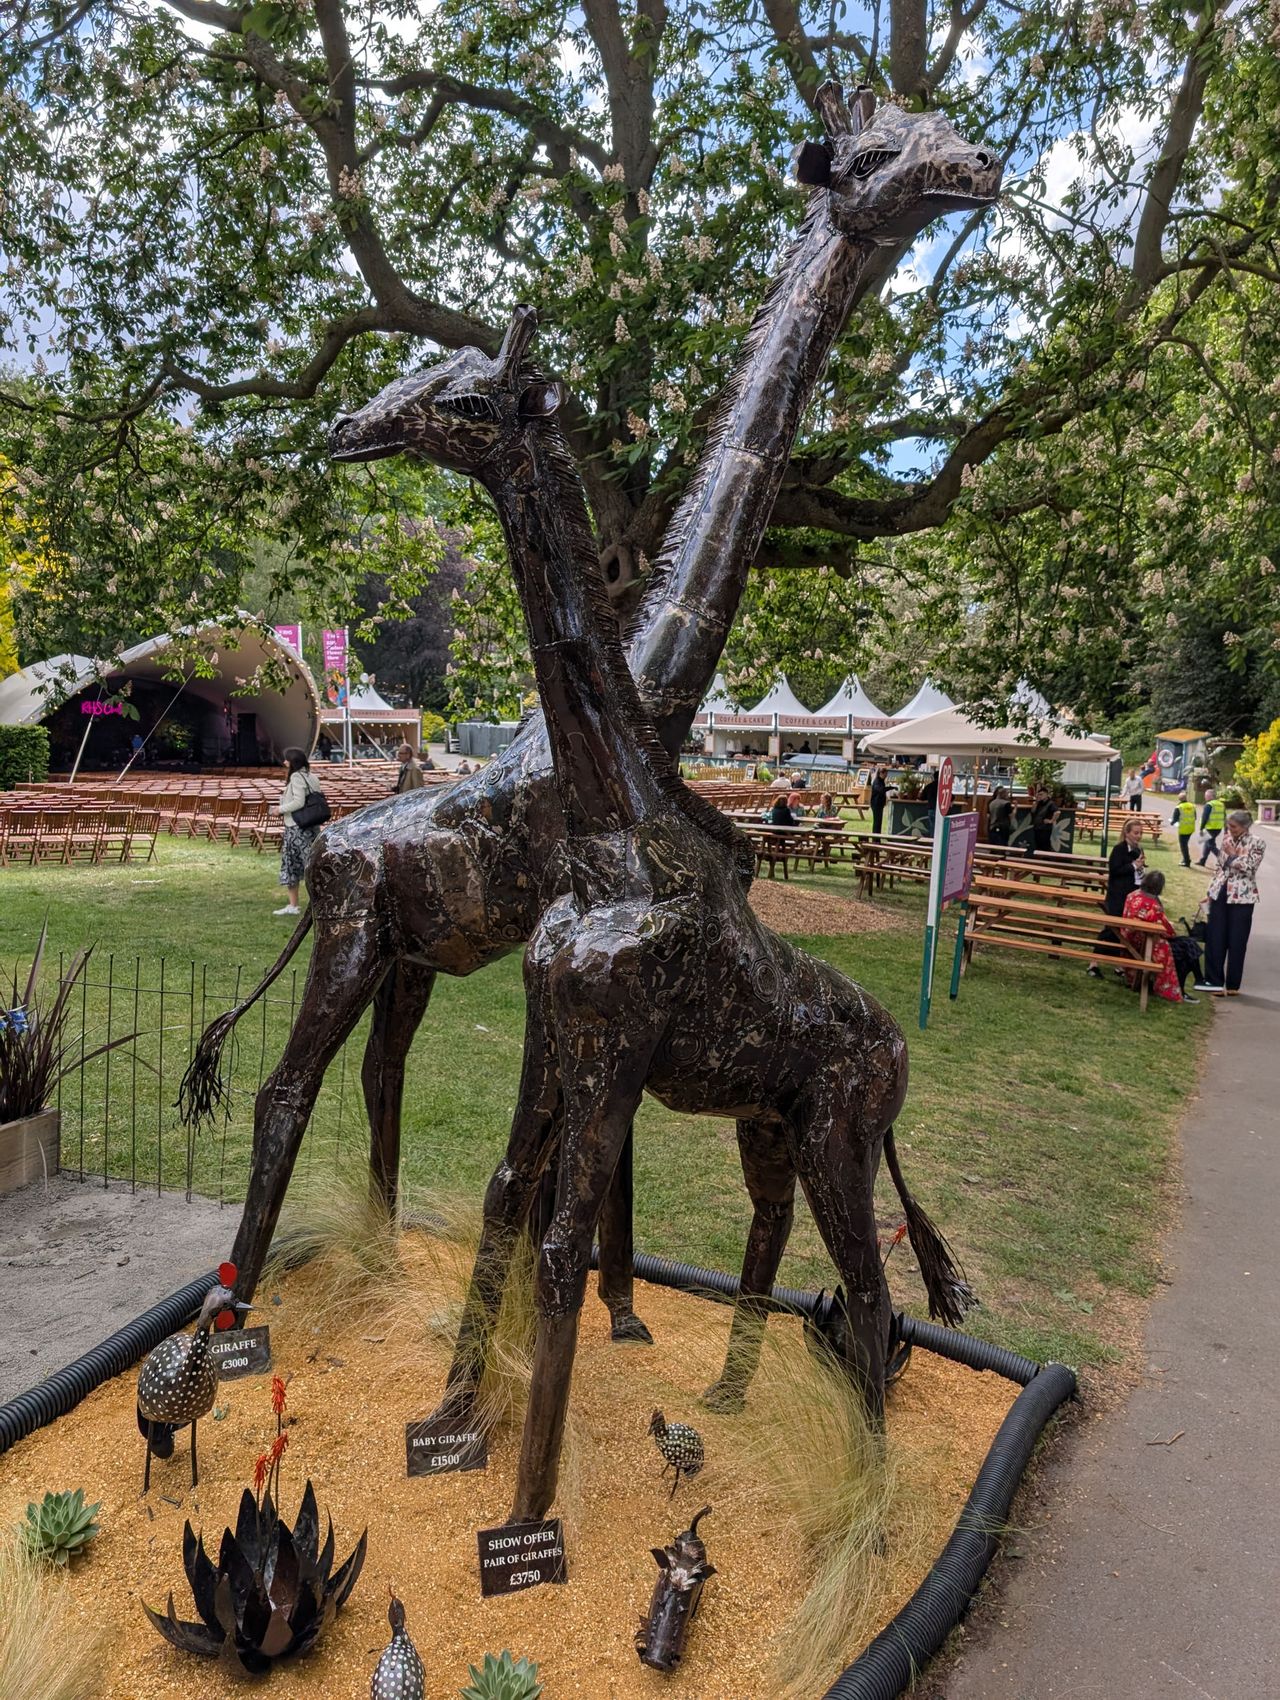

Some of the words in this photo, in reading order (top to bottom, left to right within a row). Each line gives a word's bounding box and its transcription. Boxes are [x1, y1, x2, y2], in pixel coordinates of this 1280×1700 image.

[860, 720, 889, 728] COFFEE
[942, 764, 952, 786] RP
[940, 788, 950, 810] 27
[211, 1338, 257, 1354] GIRAFFE
[221, 1356, 249, 1370] £3000
[412, 1436, 437, 1447] BABY
[438, 1432, 478, 1444] GIRAFFE
[430, 1454, 460, 1467] £1500
[488, 1536, 522, 1551] SHOW
[523, 1530, 556, 1545] OFFER
[483, 1556, 506, 1568] PAIR
[507, 1554, 520, 1564] OF
[520, 1547, 563, 1562] GIRAFFES
[509, 1569, 541, 1586] £3750
